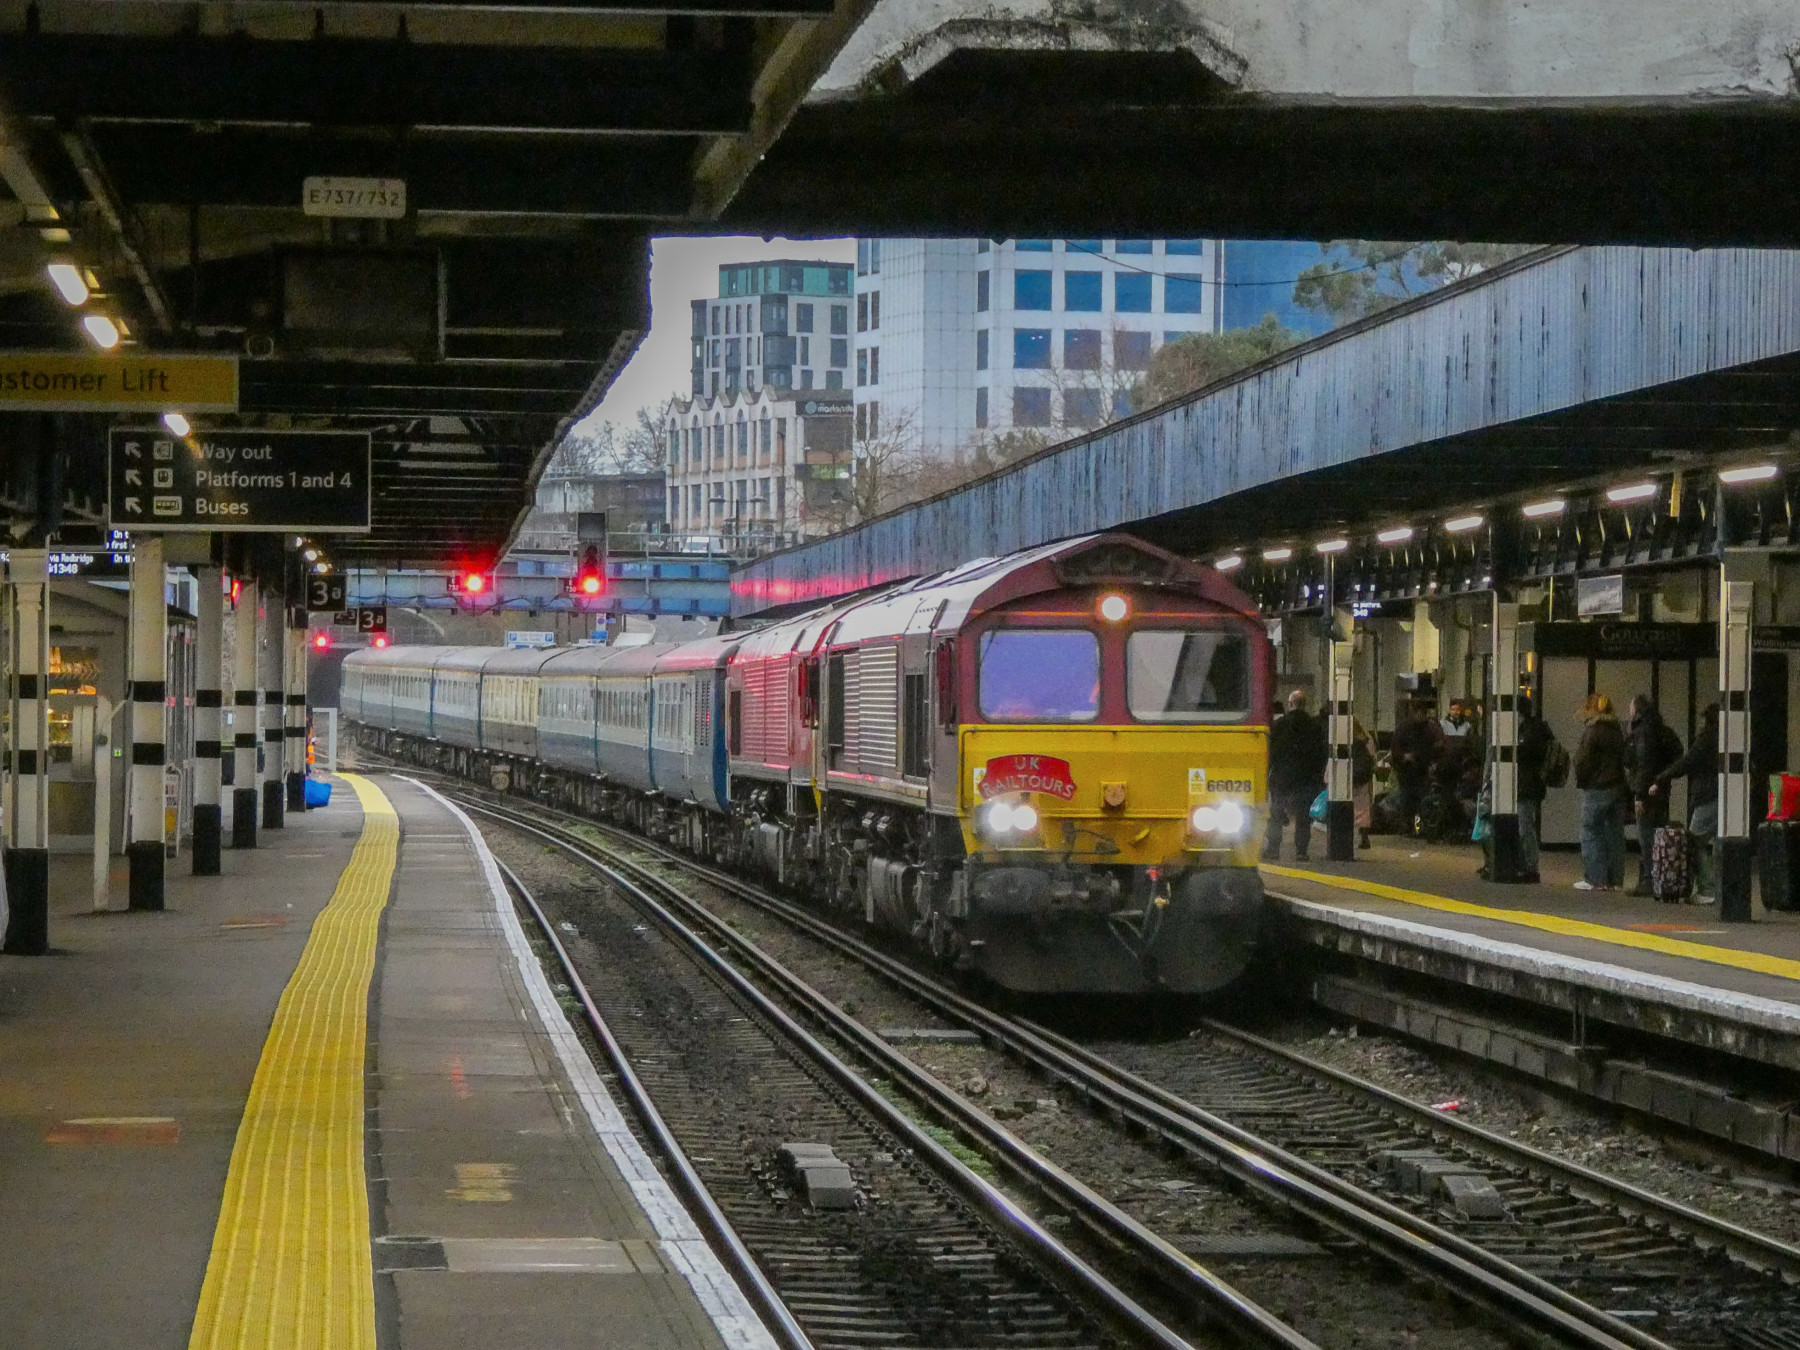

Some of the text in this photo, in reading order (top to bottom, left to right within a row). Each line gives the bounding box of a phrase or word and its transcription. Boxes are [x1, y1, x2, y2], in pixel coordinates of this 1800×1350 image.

[0, 368, 170, 392] stomer Lift
[195, 443, 273, 462] Way out
[195, 470, 353, 488] Platforms 1 and 4
[195, 499, 249, 515] Buses
[312, 581, 342, 606] 3a
[363, 610, 384, 629] 3a
[1014, 756, 1041, 771] UK
[980, 774, 1075, 799] RAILTOURS
[1207, 779, 1252, 793] 66028
